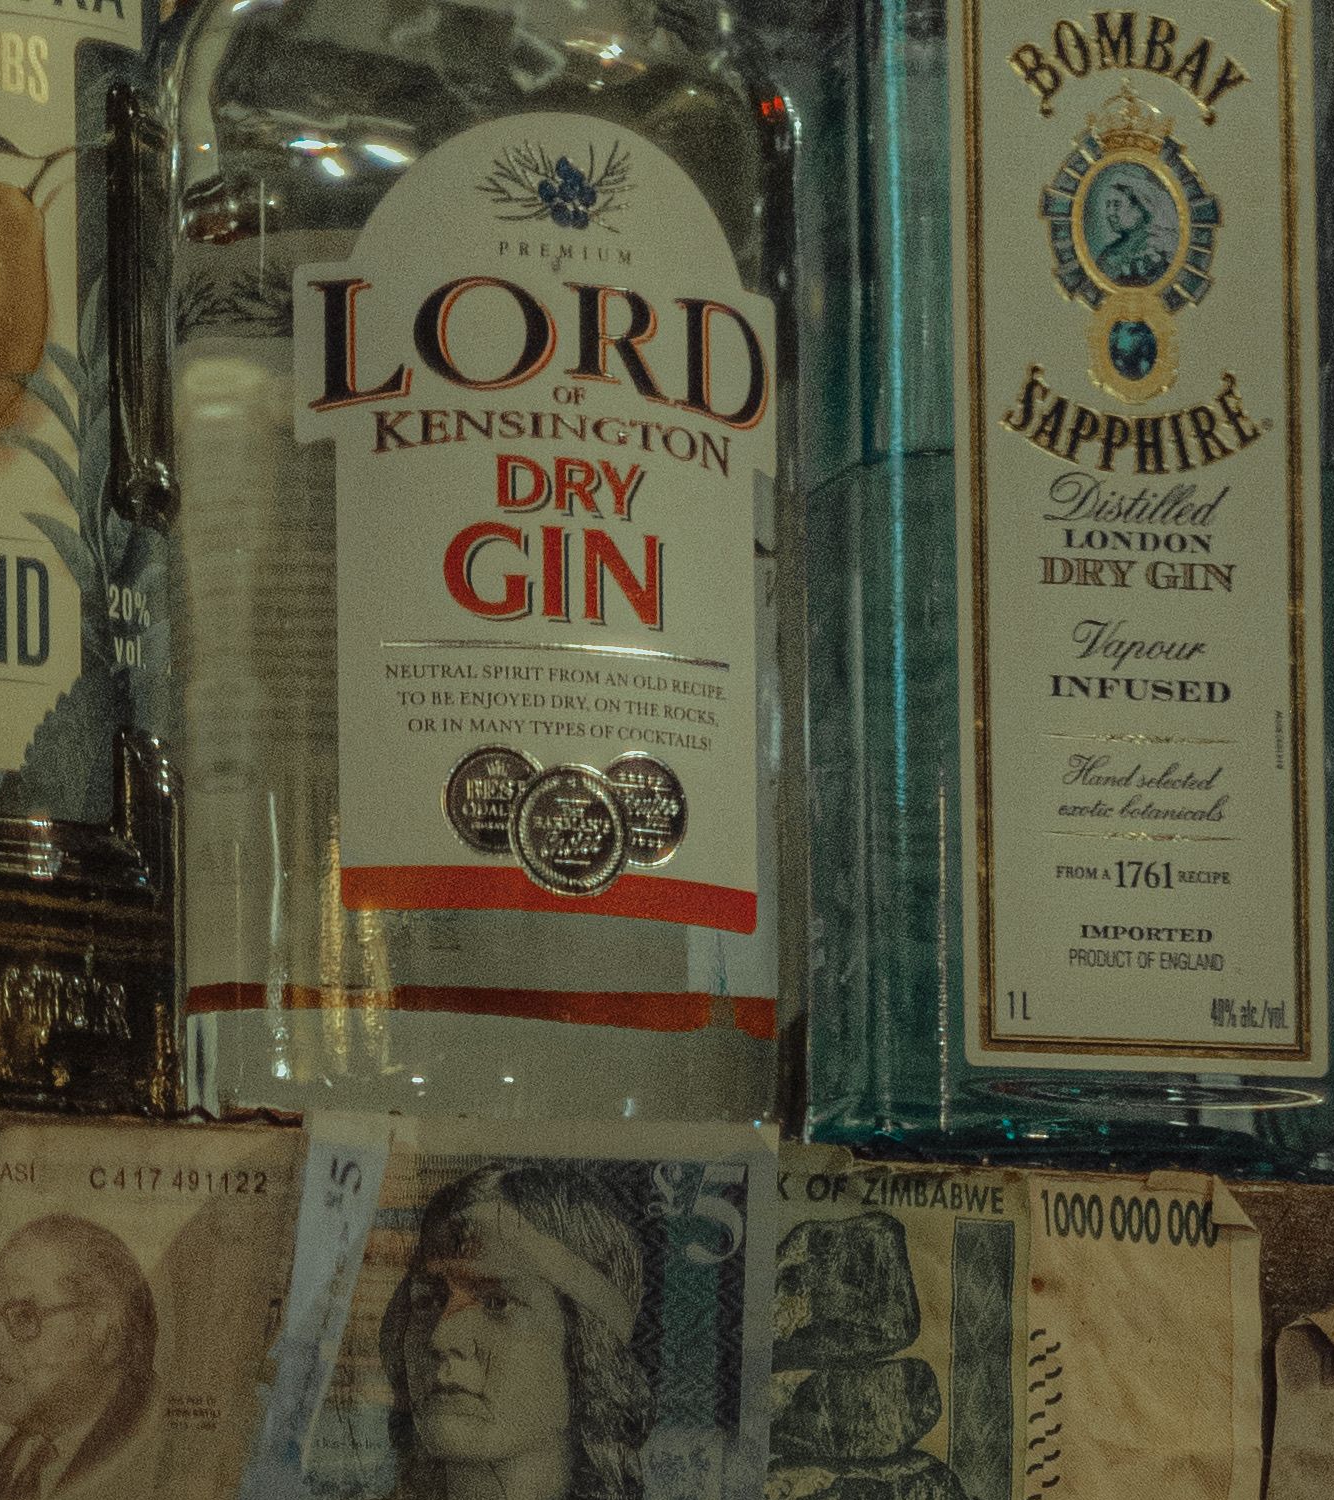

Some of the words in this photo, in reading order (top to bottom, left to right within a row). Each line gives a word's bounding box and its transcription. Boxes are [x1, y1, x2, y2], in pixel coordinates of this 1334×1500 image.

[1009, 9, 1252, 127] BOMBAY
[498, 240, 635, 266] PREMIUM
[308, 276, 769, 430] LORD
[551, 382, 587, 406] OF
[999, 364, 1265, 476] SAPPHIRE
[372, 409, 731, 477] KENSINGTON
[496, 454, 645, 520] DRY
[1043, 470, 1231, 526] Distilled
[1062, 528, 1214, 555] LONDON
[442, 521, 664, 633] GIN
[1039, 555, 1135, 589] DRY
[1144, 558, 1236, 595] GIN
[108, 582, 152, 630] 20%
[114, 634, 148, 668] vol.
[1071, 617, 1206, 672] Vapour
[385, 663, 478, 680] NEUTRAL
[481, 664, 545, 682] SPIRIT
[548, 666, 600, 685] FROM
[605, 671, 629, 686] AN
[632, 674, 668, 692] OLD
[1049, 673, 1232, 704] INFUSED
[396, 690, 426, 707] TO
[430, 691, 456, 707] BE
[460, 691, 547, 711] ENJOYED
[550, 694, 591, 713] DRY,
[594, 698, 621, 714] ON
[624, 700, 660, 719] THE
[407, 718, 438, 734] OR
[441, 718, 464, 733] IN
[468, 719, 525, 735] MANY
[529, 720, 586, 738] TYPES
[589, 724, 614, 740] OF
[1062, 752, 1140, 789] Hand
[1136, 761, 1224, 792] selected
[1057, 799, 1115, 819] exotic
[1117, 793, 1232, 823] botanicals
[1054, 865, 1099, 880] FROM
[1101, 868, 1112, 881] A
[1114, 860, 1175, 890] 1761
[1177, 869, 1232, 886] RECIPE
[1079, 923, 1214, 944] IMPORTED
[1068, 948, 1134, 969] PRODUCT
[1137, 950, 1156, 970] OF
[1159, 951, 1225, 972] ENGLAND
[88, 1167, 163, 1192] C417
[171, 1168, 269, 1196] 491122
[806, 1172, 848, 1203] OF
[860, 1173, 1005, 1215] ZIMBABWE
[1040, 1188, 1105, 1241] 1000
[1111, 1196, 1162, 1245] 000
